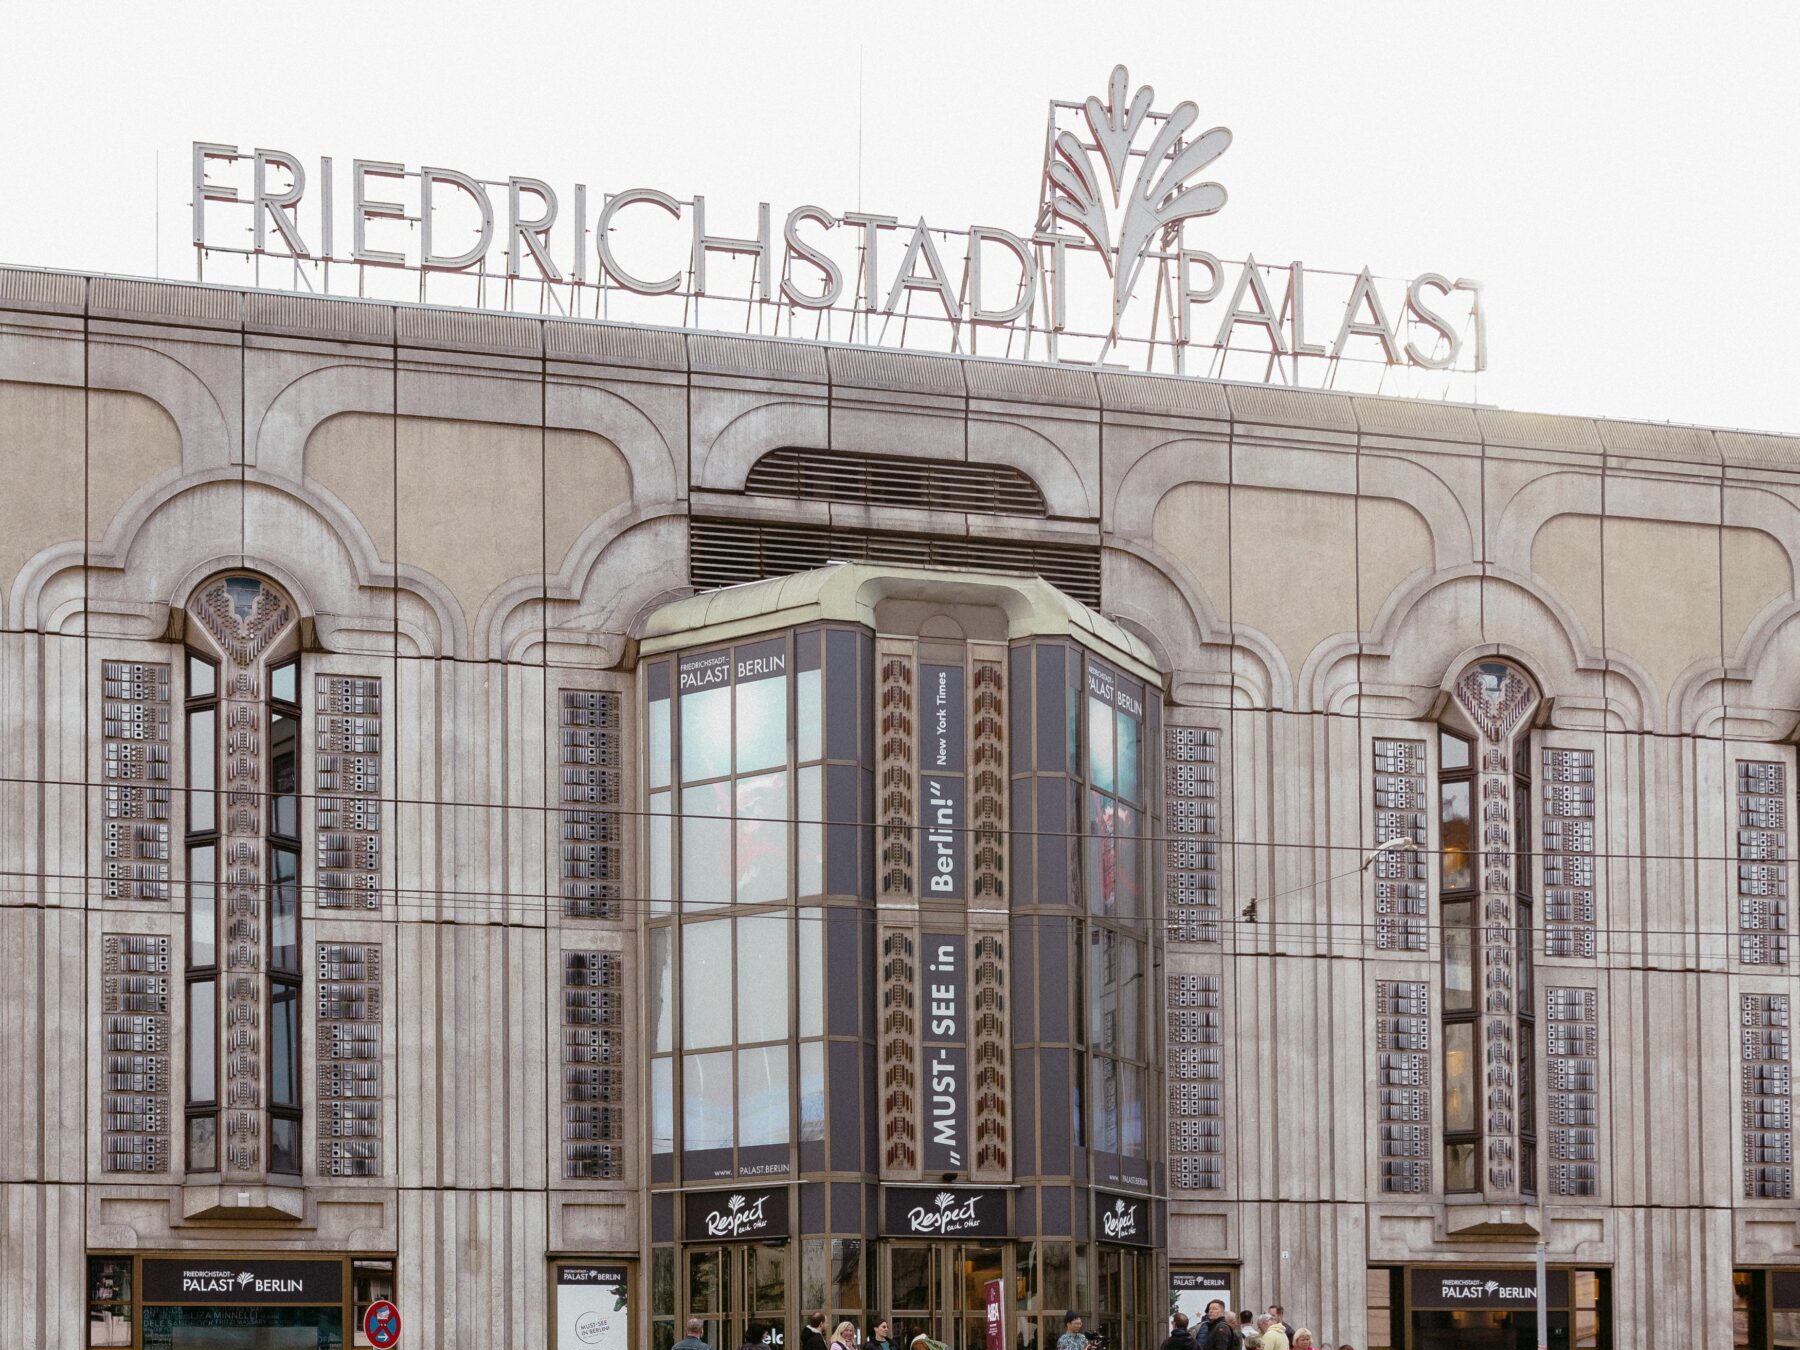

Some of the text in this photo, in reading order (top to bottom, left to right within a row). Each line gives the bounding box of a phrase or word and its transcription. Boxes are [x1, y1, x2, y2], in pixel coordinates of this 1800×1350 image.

[191, 140, 1488, 373] FRIEDRICHSTADT PALAST
[680, 653, 785, 689] PALAST BERLIN
[936, 671, 947, 766] New York Times
[1117, 691, 1142, 717] BERLIN
[929, 945, 955, 971] in
[931, 984, 956, 1036] SEE
[739, 1164, 790, 1175] PALAST.BERLIN
[705, 1194, 771, 1236] Respect
[907, 1195, 984, 1234] Respect
[946, 1218, 981, 1232] each other
[1103, 1205, 1138, 1239] Respect
[183, 1279, 303, 1292] PALAST BERLIN
[1442, 1287, 1537, 1299] PALAST BERLIN
[213, 1311, 258, 1320] MINNELLI
